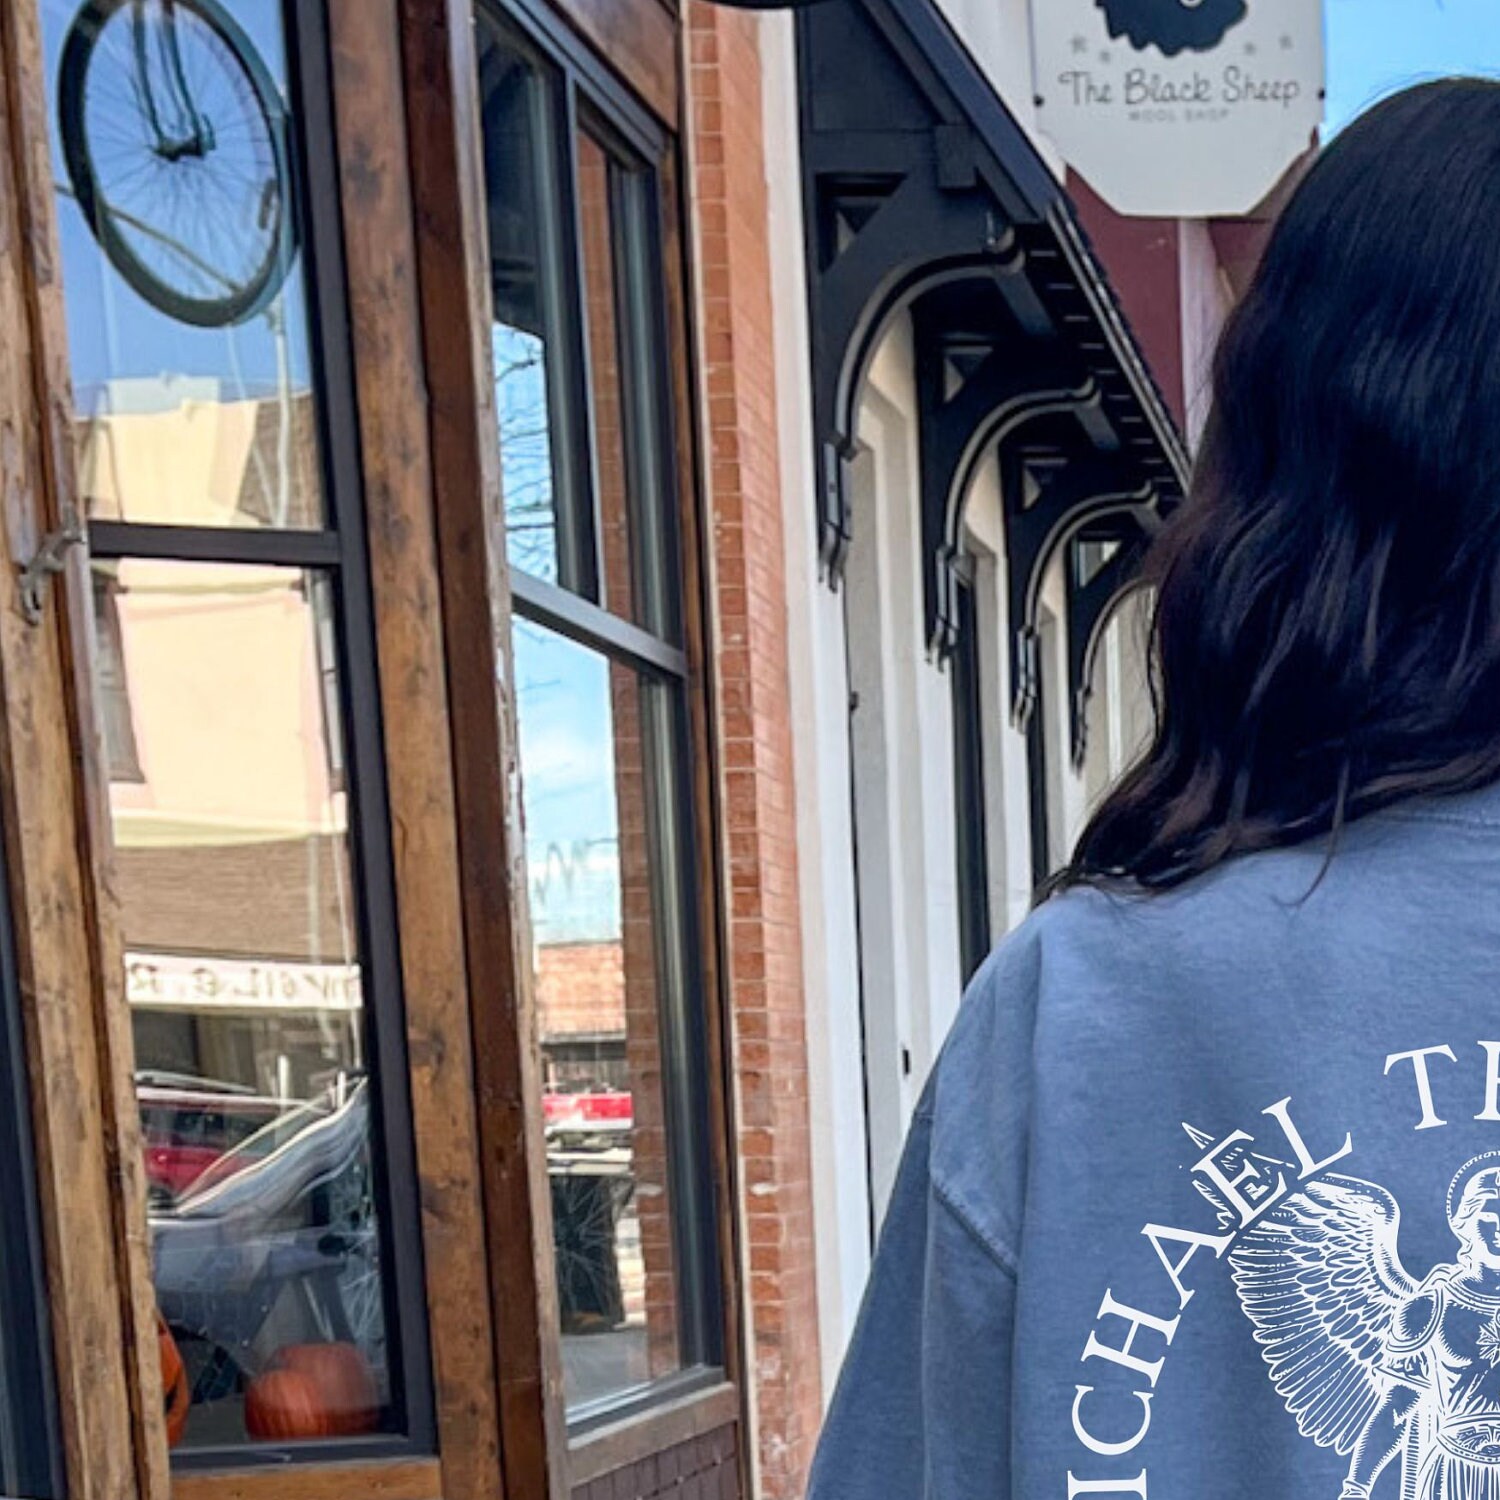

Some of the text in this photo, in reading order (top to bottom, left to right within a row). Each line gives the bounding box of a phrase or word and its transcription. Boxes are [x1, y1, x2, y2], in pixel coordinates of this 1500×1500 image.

[1058, 65, 1301, 110] The Black Sheep
[1185, 109, 1230, 122] SHOP
